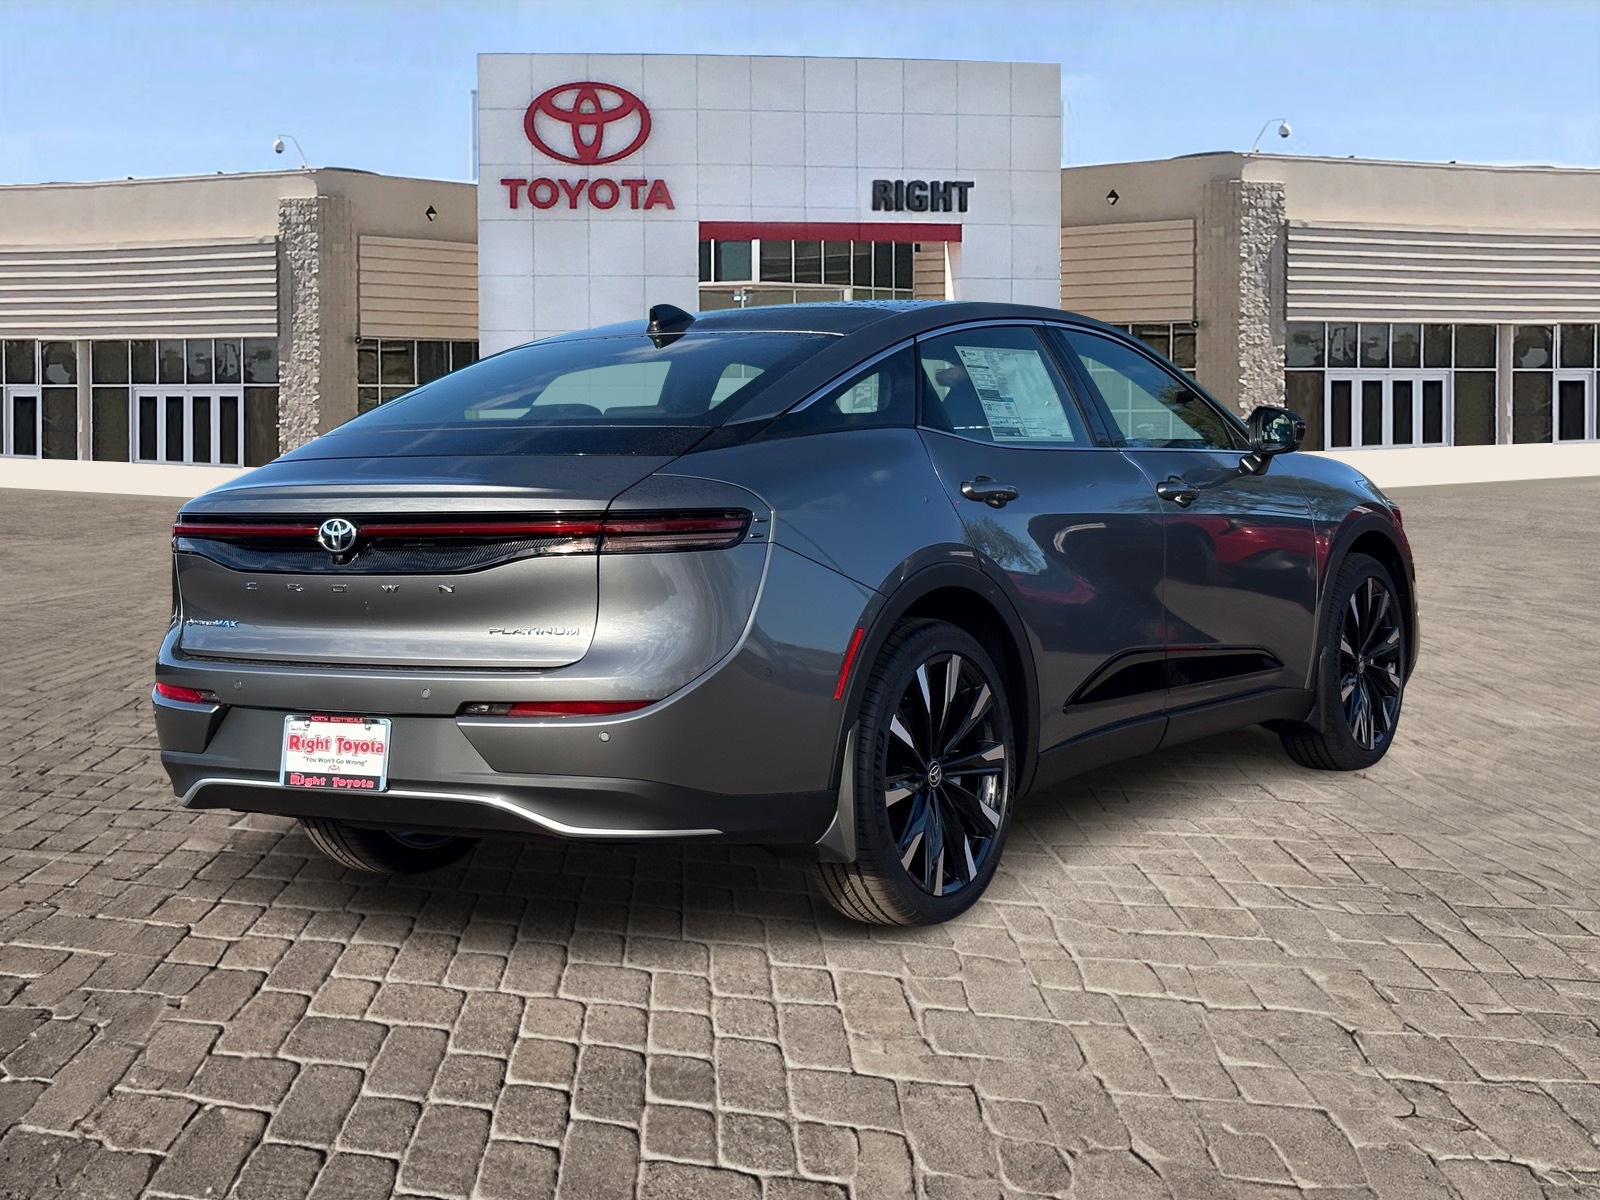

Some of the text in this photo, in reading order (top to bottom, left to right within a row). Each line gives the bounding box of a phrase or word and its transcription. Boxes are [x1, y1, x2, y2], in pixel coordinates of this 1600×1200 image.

[500, 178, 675, 211] TOYOTA
[871, 179, 975, 213] RIGHT
[489, 627, 580, 636] PLATINUM
[287, 733, 385, 757] Right Toyota
[290, 773, 374, 788] Right Toyota
